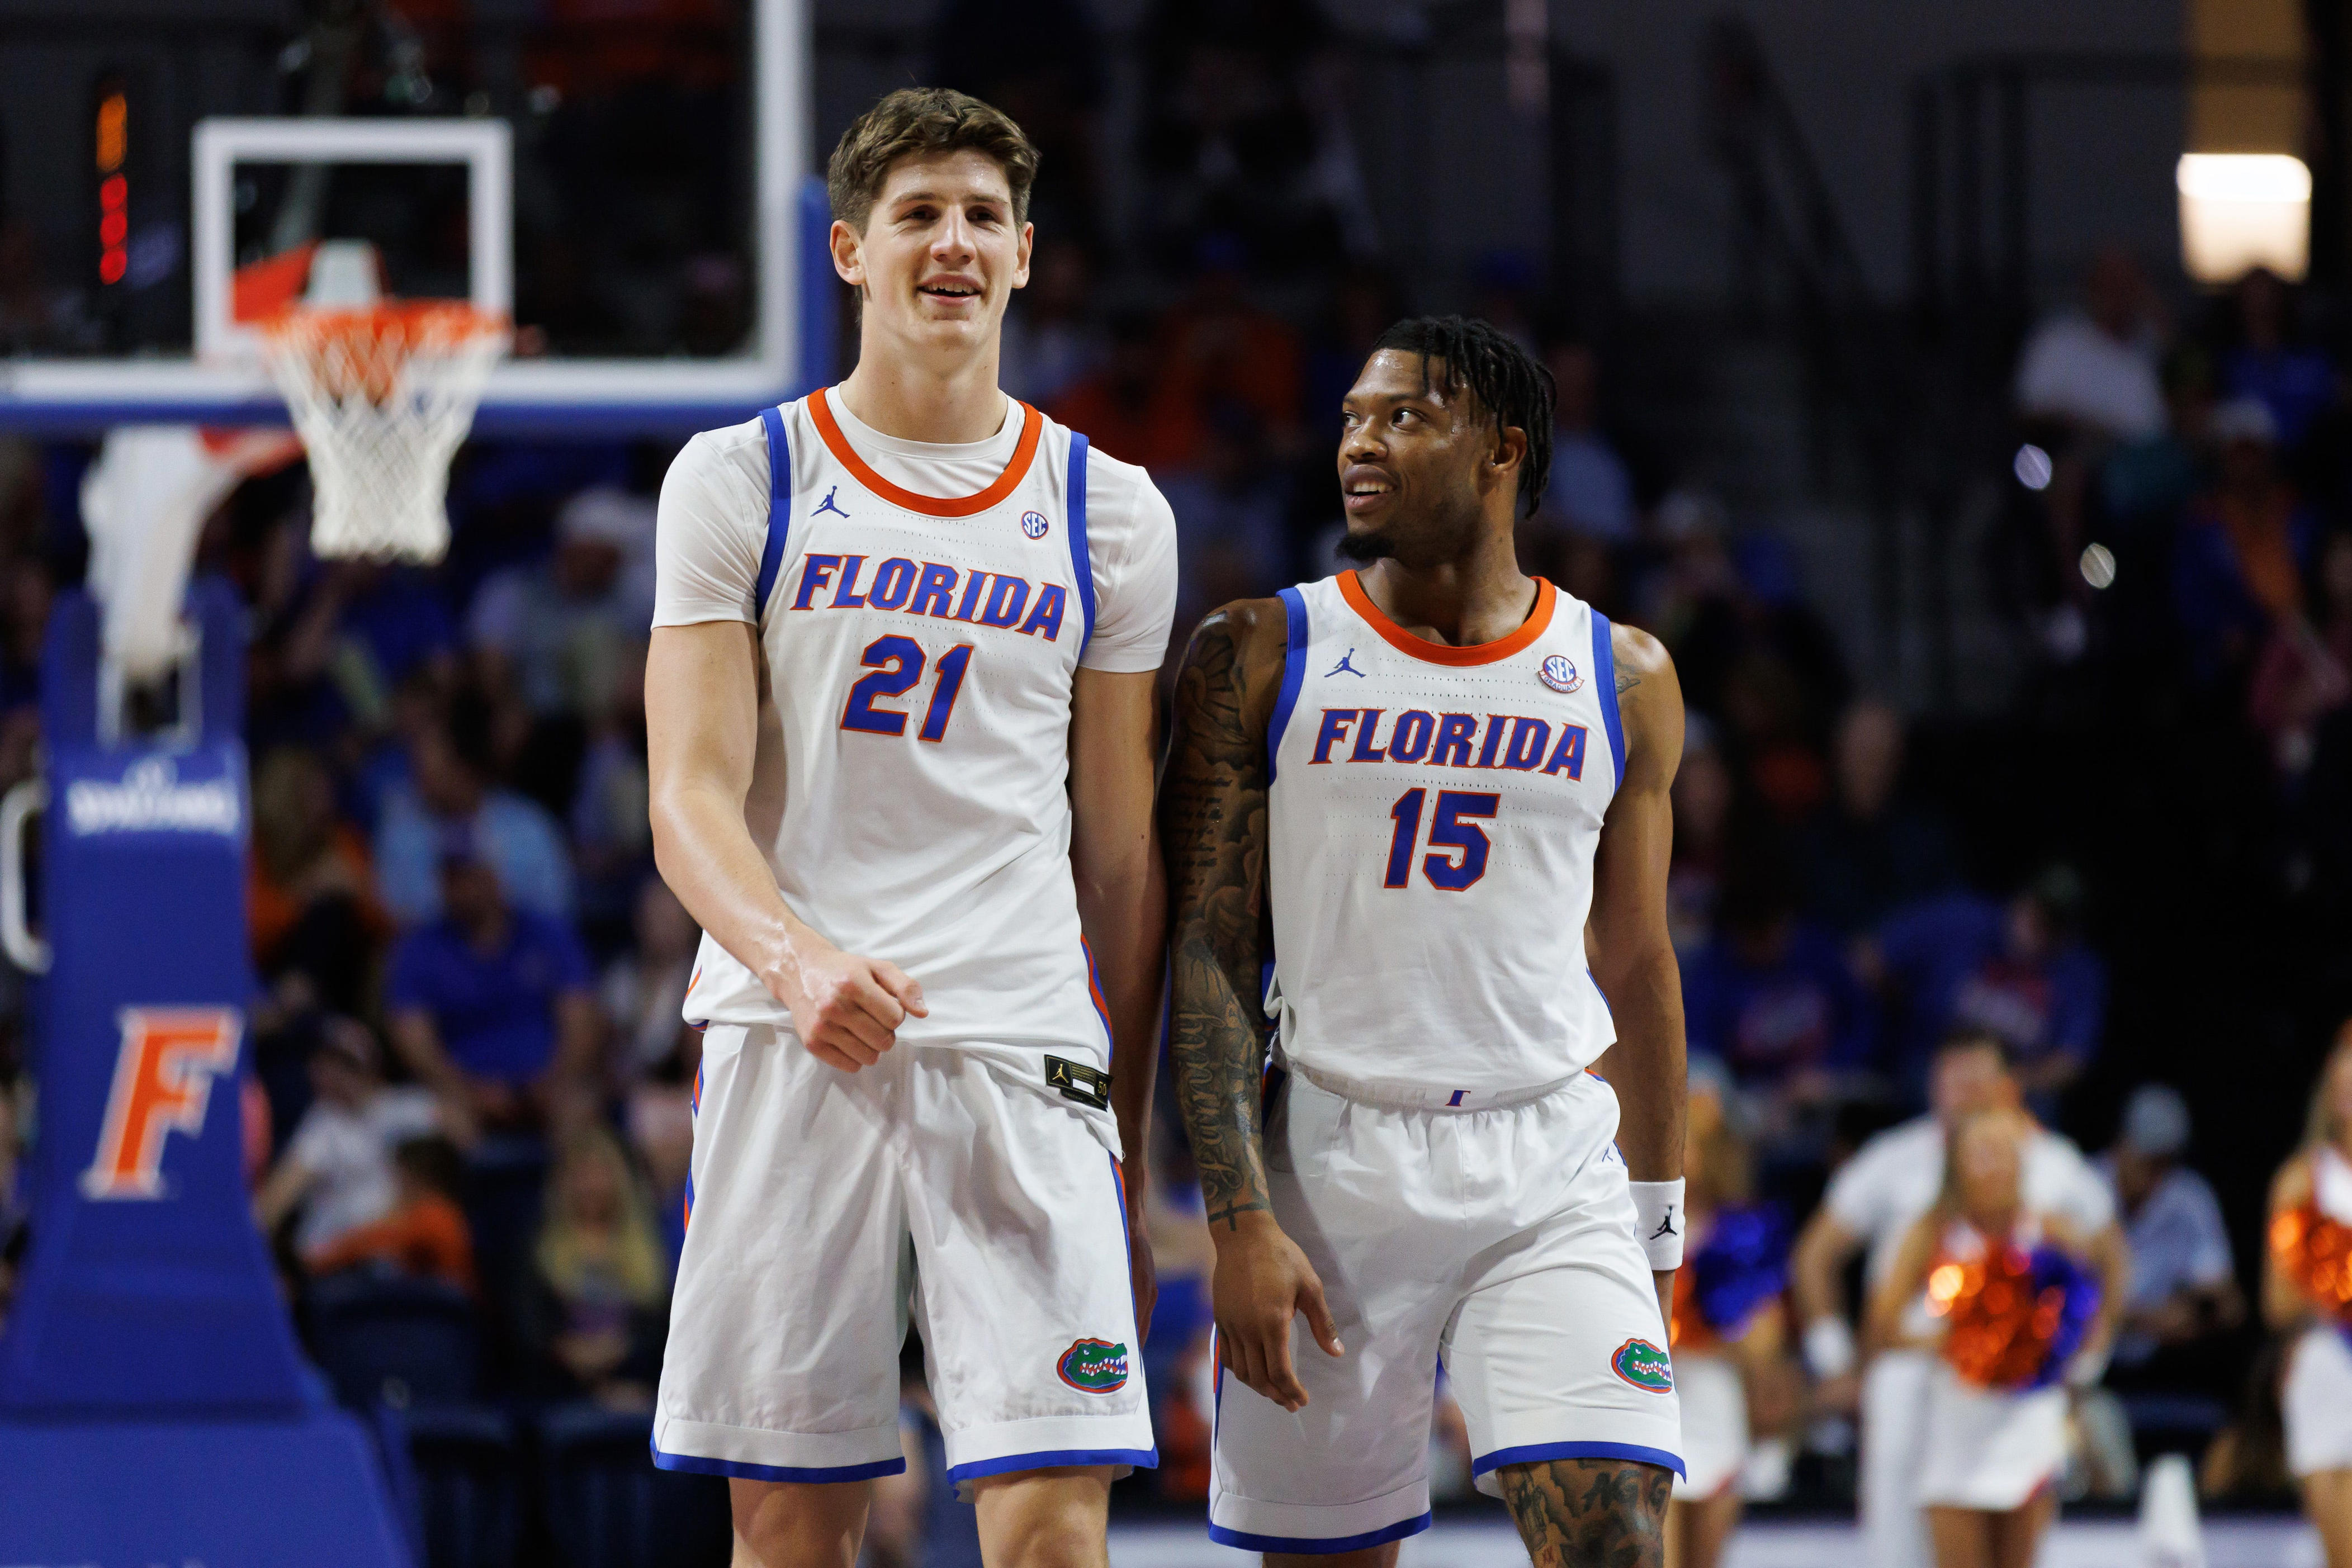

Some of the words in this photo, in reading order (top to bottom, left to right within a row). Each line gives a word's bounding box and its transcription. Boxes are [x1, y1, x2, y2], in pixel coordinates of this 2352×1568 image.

[1023, 511, 1047, 538] SEC
[789, 553, 1067, 642] FLORIDA
[840, 633, 974, 743] 21
[1544, 676, 1578, 691] GRADUATE
[1545, 656, 1575, 683] SEC
[1308, 708, 1588, 783] FLORIDA
[1384, 787, 1501, 892] 15
[78, 1005, 247, 1202] F
